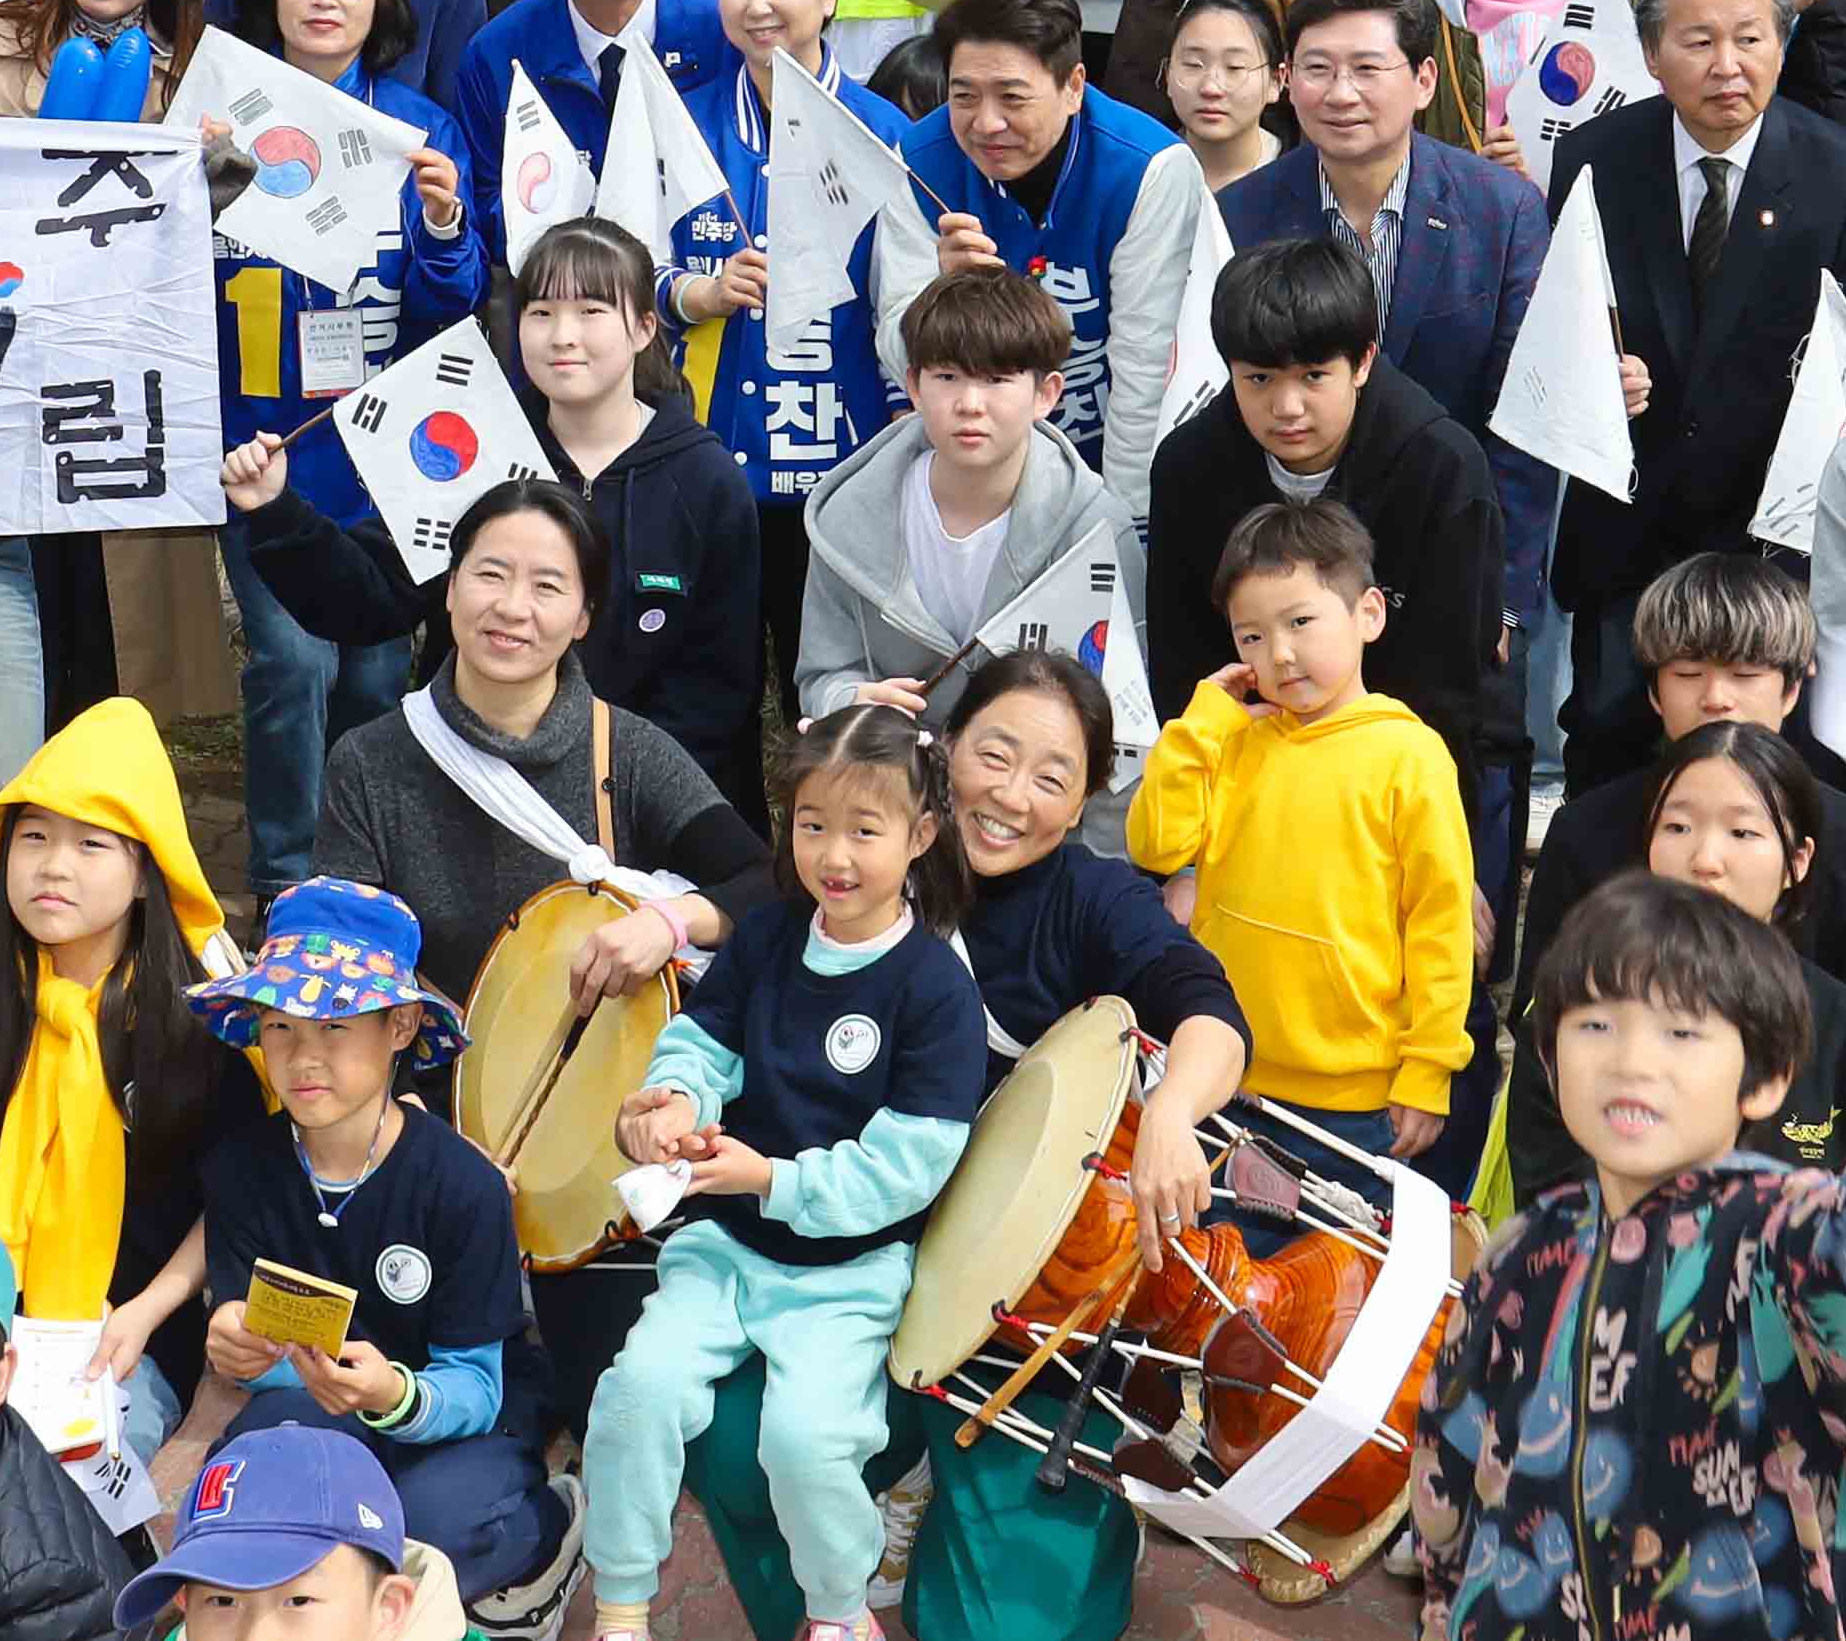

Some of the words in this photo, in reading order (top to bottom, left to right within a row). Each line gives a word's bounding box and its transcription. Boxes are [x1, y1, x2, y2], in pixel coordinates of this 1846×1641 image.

[691, 221, 738, 243] 민주당
[224, 267, 281, 397] 1
[770, 470, 827, 495] 배우
